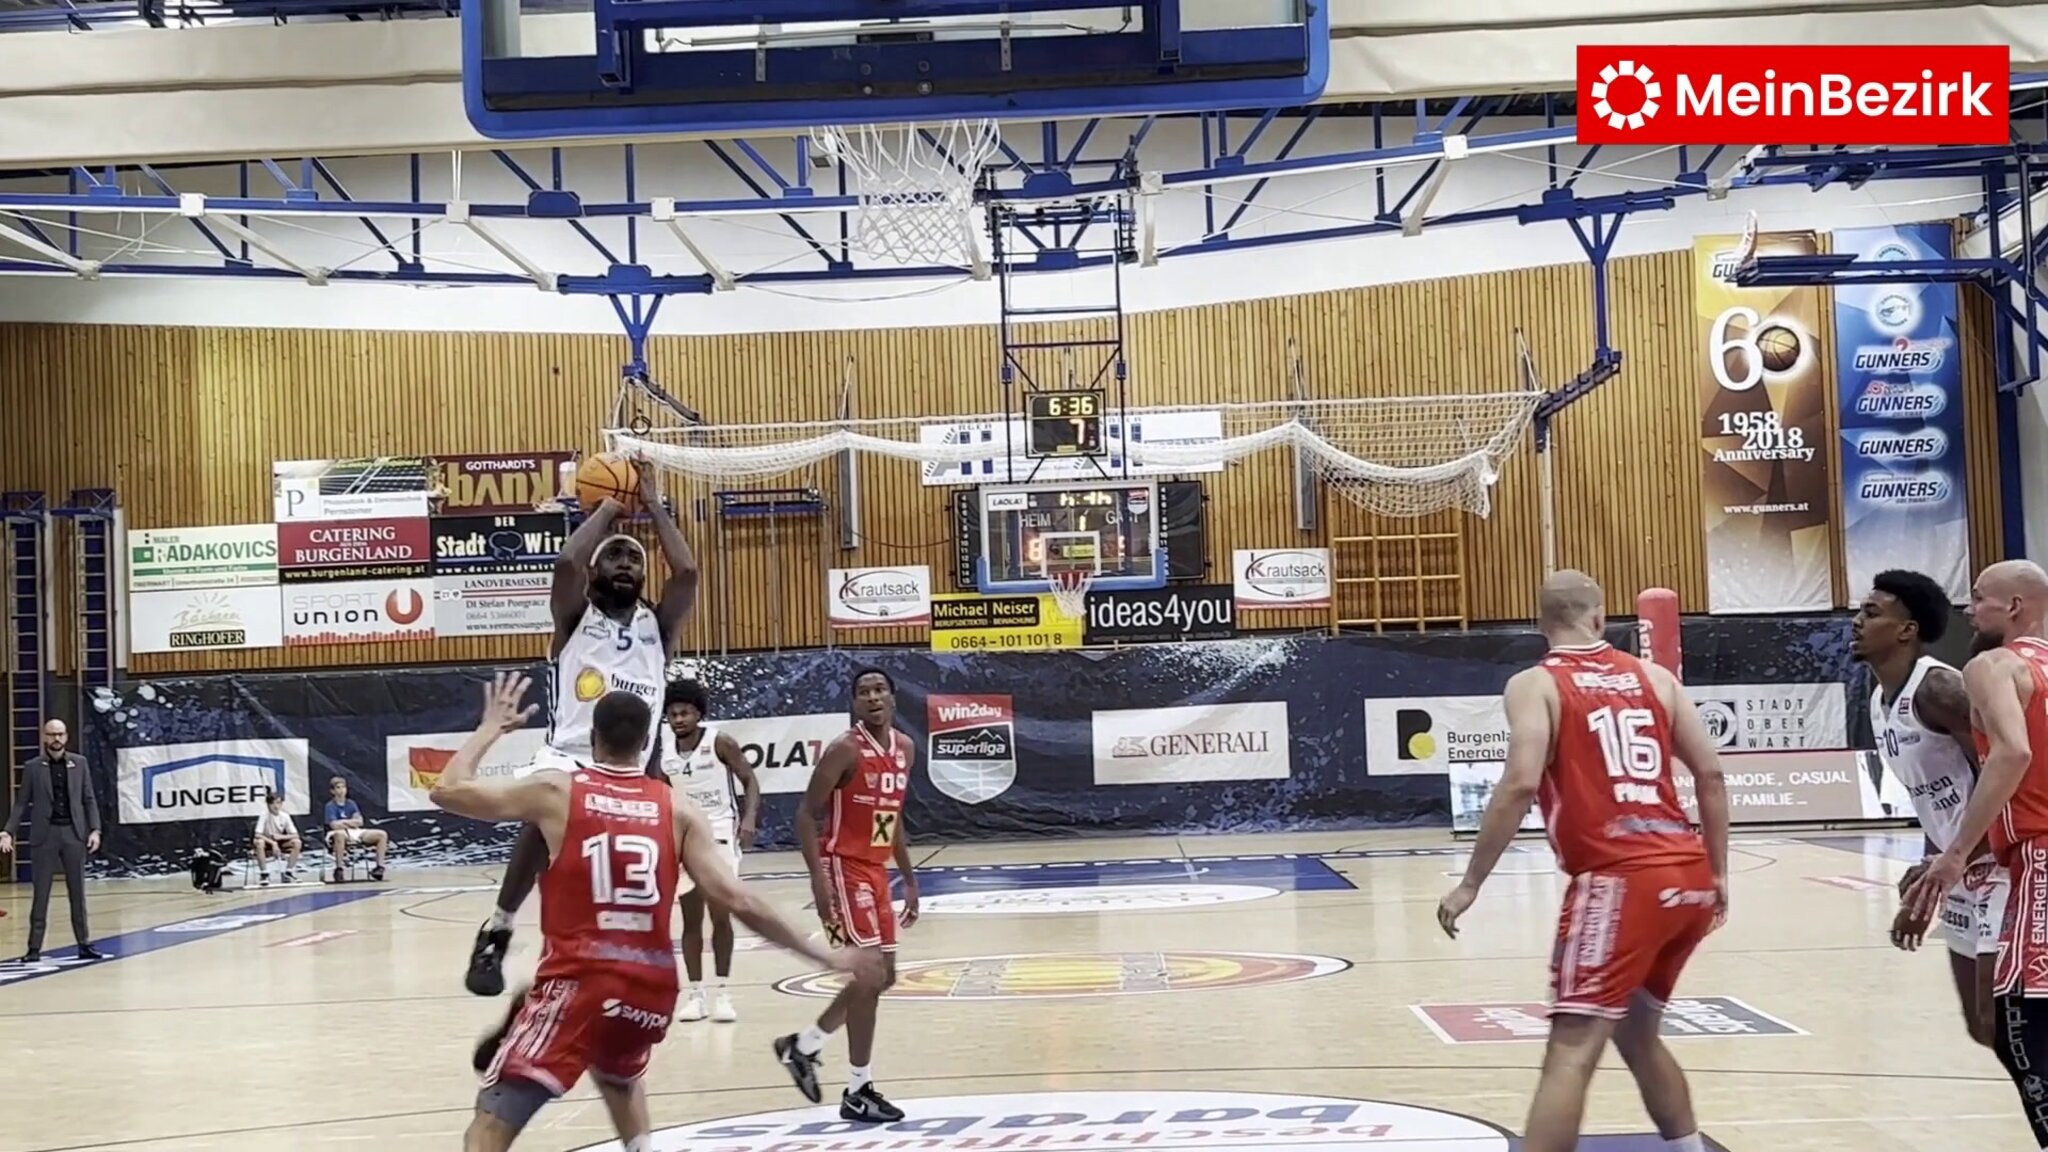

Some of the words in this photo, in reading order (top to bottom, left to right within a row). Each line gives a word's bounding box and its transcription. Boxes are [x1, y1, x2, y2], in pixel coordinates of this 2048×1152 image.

[1856, 352, 1930, 369] GUNNERS
[1049, 396, 1093, 416] 6:36
[1858, 395, 1934, 412] GUNNERS
[1069, 418, 1085, 445] 7
[1718, 411, 1779, 435] 1958
[1742, 426, 1804, 450] 2018
[1860, 438, 1935, 455] GUNNERS
[1713, 447, 1815, 462] Anniversary
[465, 459, 536, 471] GOTTHARDT'S
[1861, 481, 1938, 499] GUNNERS
[1723, 502, 1809, 515] www.gunners.at
[309, 526, 396, 543] CATERING
[295, 545, 412, 563] BURGENLAND
[436, 532, 487, 558] Stadt
[285, 565, 425, 578] www.burgenland-catering.at
[1250, 552, 1327, 578] Krautsack
[464, 577, 548, 589] LANDVERMESSER
[844, 572, 920, 597] Krautsack
[293, 592, 378, 610] SPORT
[934, 602, 988, 617] Michael
[993, 599, 1036, 615] Neiser
[294, 609, 378, 625] union
[1090, 594, 1232, 632] ideas4you
[171, 631, 245, 647] RINGHOFER
[616, 627, 632, 651] 5
[937, 702, 1002, 722] win2day
[1746, 699, 1804, 711] STADT
[1747, 717, 1805, 730] OBER
[937, 741, 1006, 756] superliga
[1150, 731, 1269, 757] GENERALI
[1587, 705, 1662, 780] 16
[1748, 735, 1806, 749] WART
[1883, 727, 1899, 757] 10
[1448, 746, 1505, 761] Energie
[682, 762, 693, 777] 4
[1789, 771, 1852, 785] CASUAL
[156, 785, 272, 808] UNGER
[582, 832, 660, 906] 13
